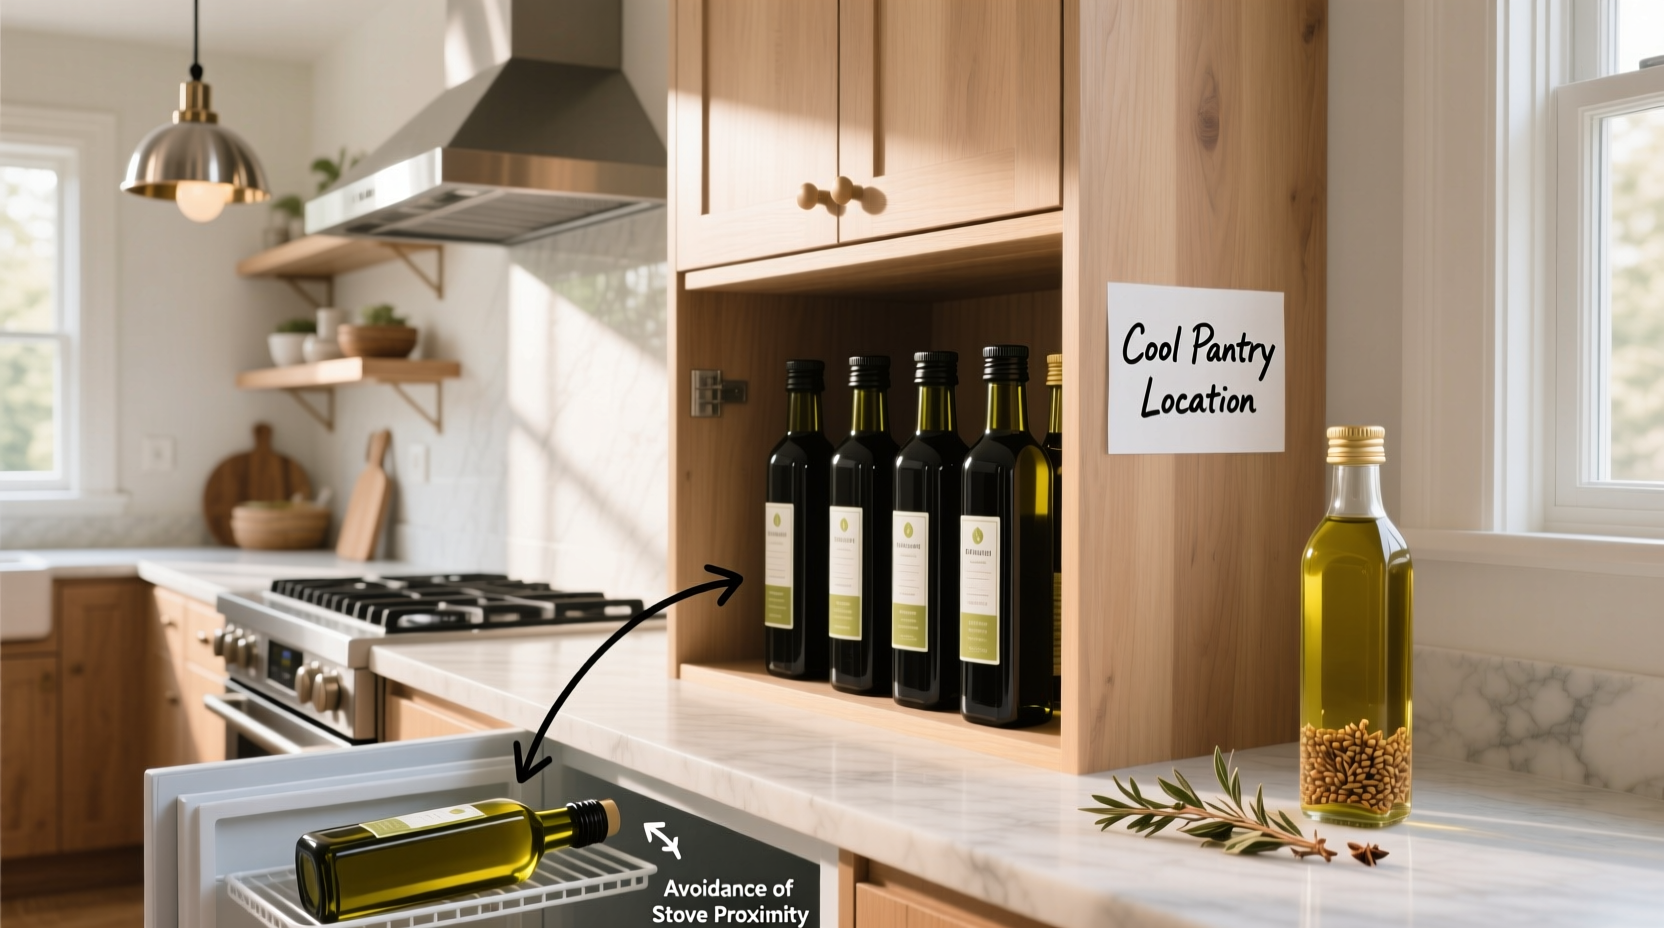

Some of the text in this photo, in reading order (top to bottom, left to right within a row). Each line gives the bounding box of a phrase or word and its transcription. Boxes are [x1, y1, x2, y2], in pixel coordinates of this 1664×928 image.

[1122, 322, 1276, 382] Cool Pantry
[1140, 376, 1257, 419] Location
